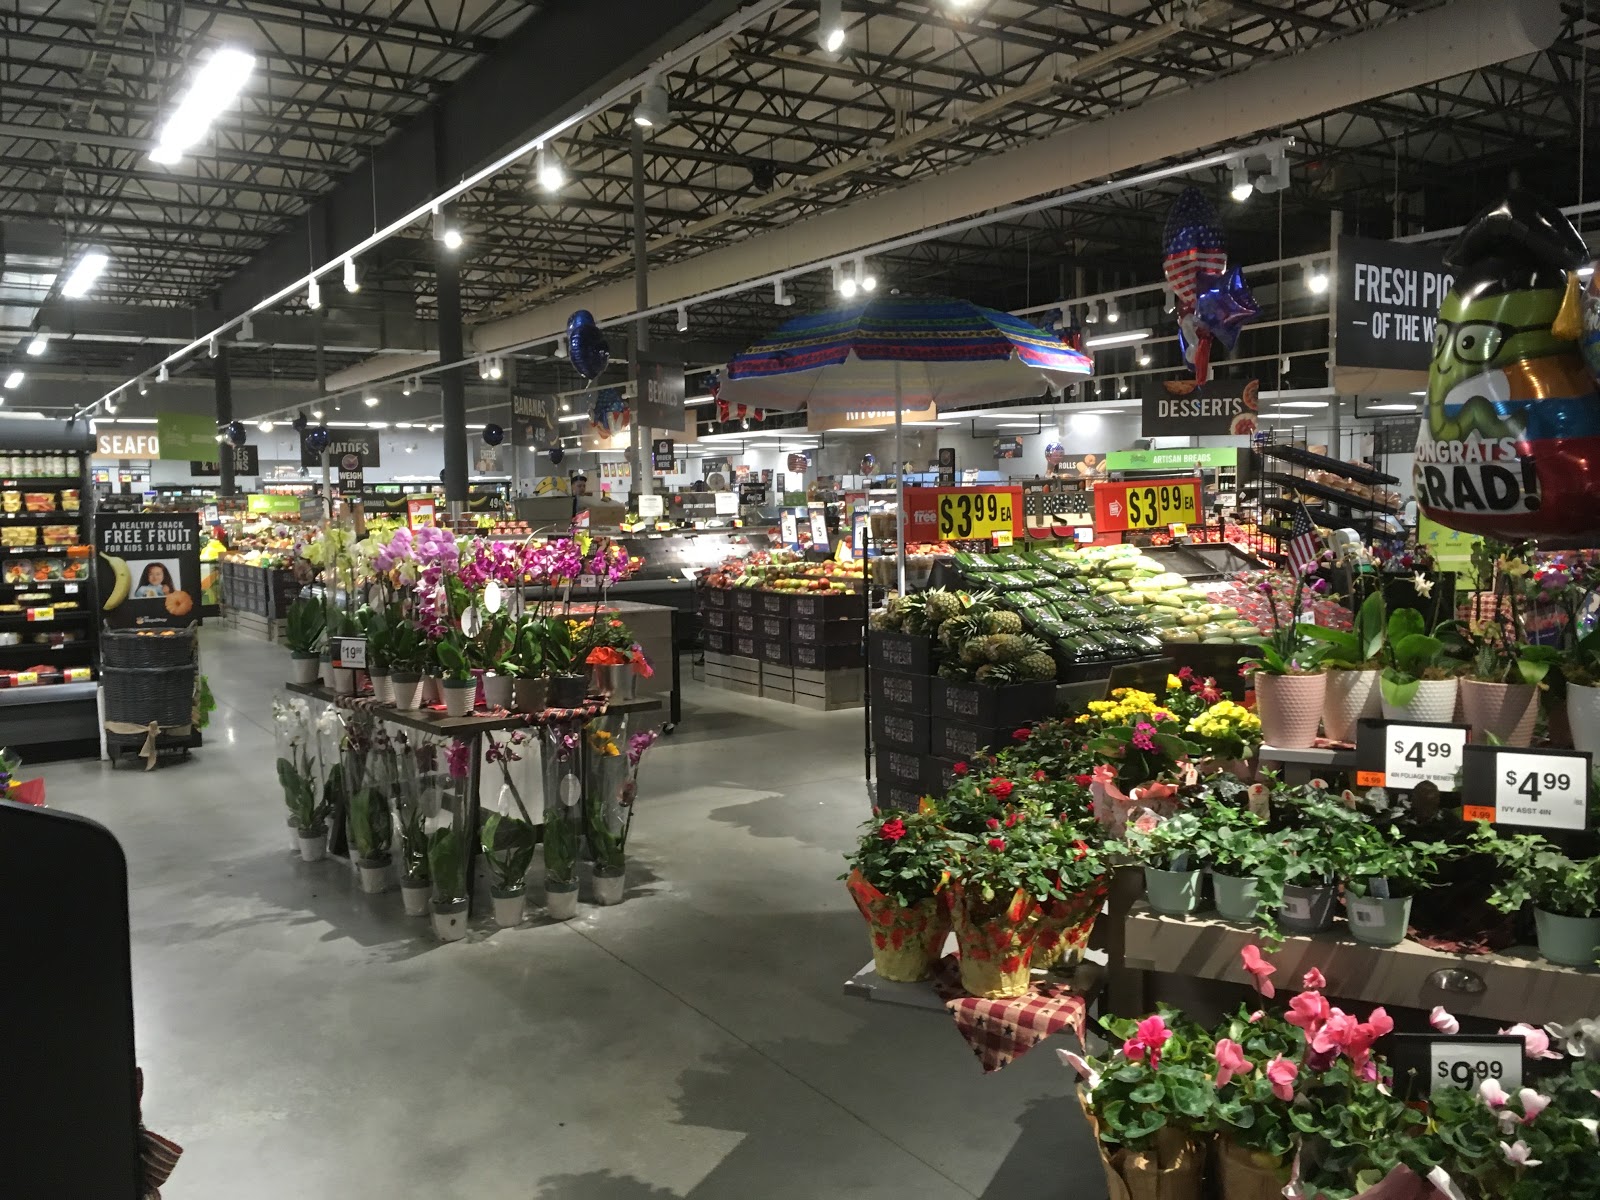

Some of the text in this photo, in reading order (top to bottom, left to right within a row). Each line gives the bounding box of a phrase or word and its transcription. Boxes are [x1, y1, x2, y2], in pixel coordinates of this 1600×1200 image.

[1354, 263, 1418, 307] FRESH
[1372, 311, 1391, 339] OF
[1393, 313, 1420, 342] THE
[1158, 397, 1243, 418] DESSERTS
[1058, 461, 1077, 470] ROLLS
[1152, 455, 1181, 464] ARTISAN
[1183, 453, 1211, 463] BREADS
[339, 471, 362, 480] WEIGH
[1413, 463, 1541, 511] GRAD!
[1184, 496, 1194, 510] EA
[1000, 506, 1012, 522] EA
[111, 520, 184, 530] A HEALTHY SNACK
[104, 528, 191, 544] FREE FRUIT
[105, 543, 192, 553] FOR KIDS 10 & UNDER
[1400, 772, 1425, 780] FOLIAGE
